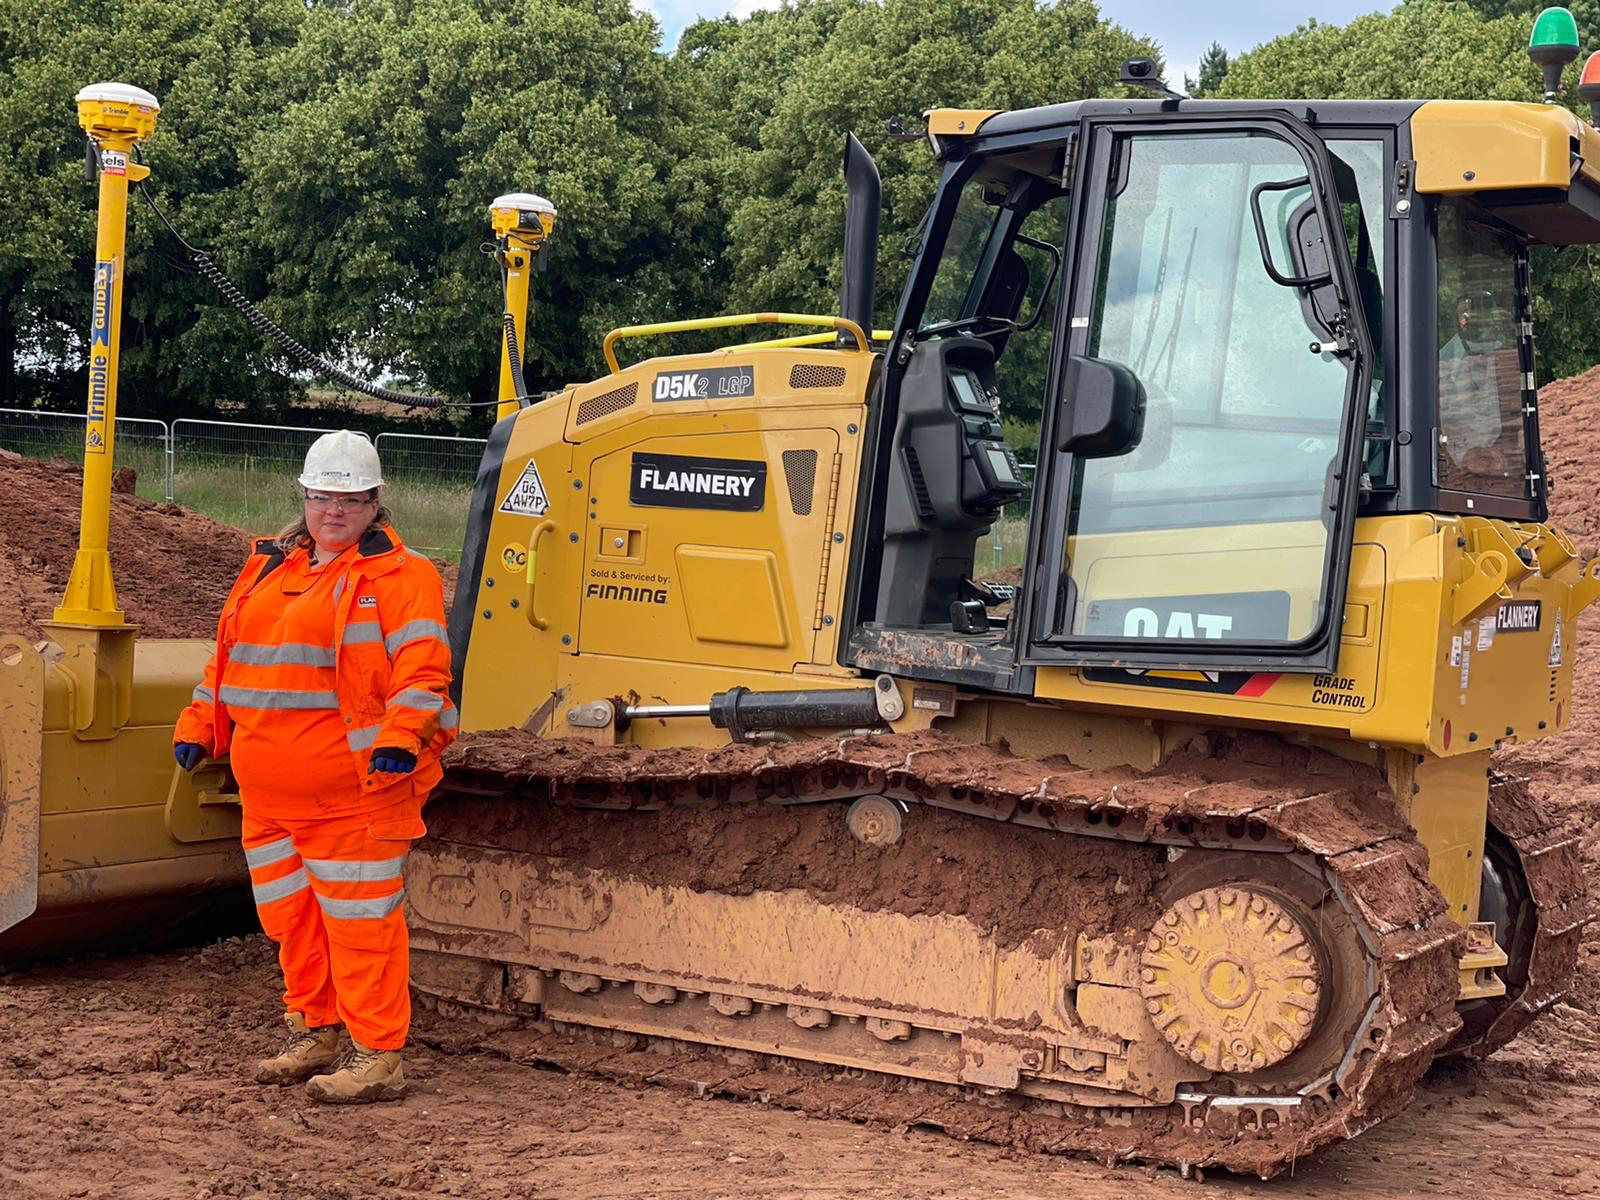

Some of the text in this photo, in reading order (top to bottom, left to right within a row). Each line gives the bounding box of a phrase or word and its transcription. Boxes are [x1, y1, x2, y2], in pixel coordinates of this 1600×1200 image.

[104, 157, 125, 167] els
[95, 269, 108, 330] GUIDED
[88, 355, 107, 424] Trimble
[718, 375, 752, 396] LGP
[640, 469, 756, 497] FLANNERY
[590, 568, 671, 585] Sold & Serviced by:
[586, 583, 668, 604] FINNING
[1497, 605, 1539, 629] FLANNERY
[1313, 674, 1356, 691] GRADE
[1312, 689, 1366, 708] CONTROL
